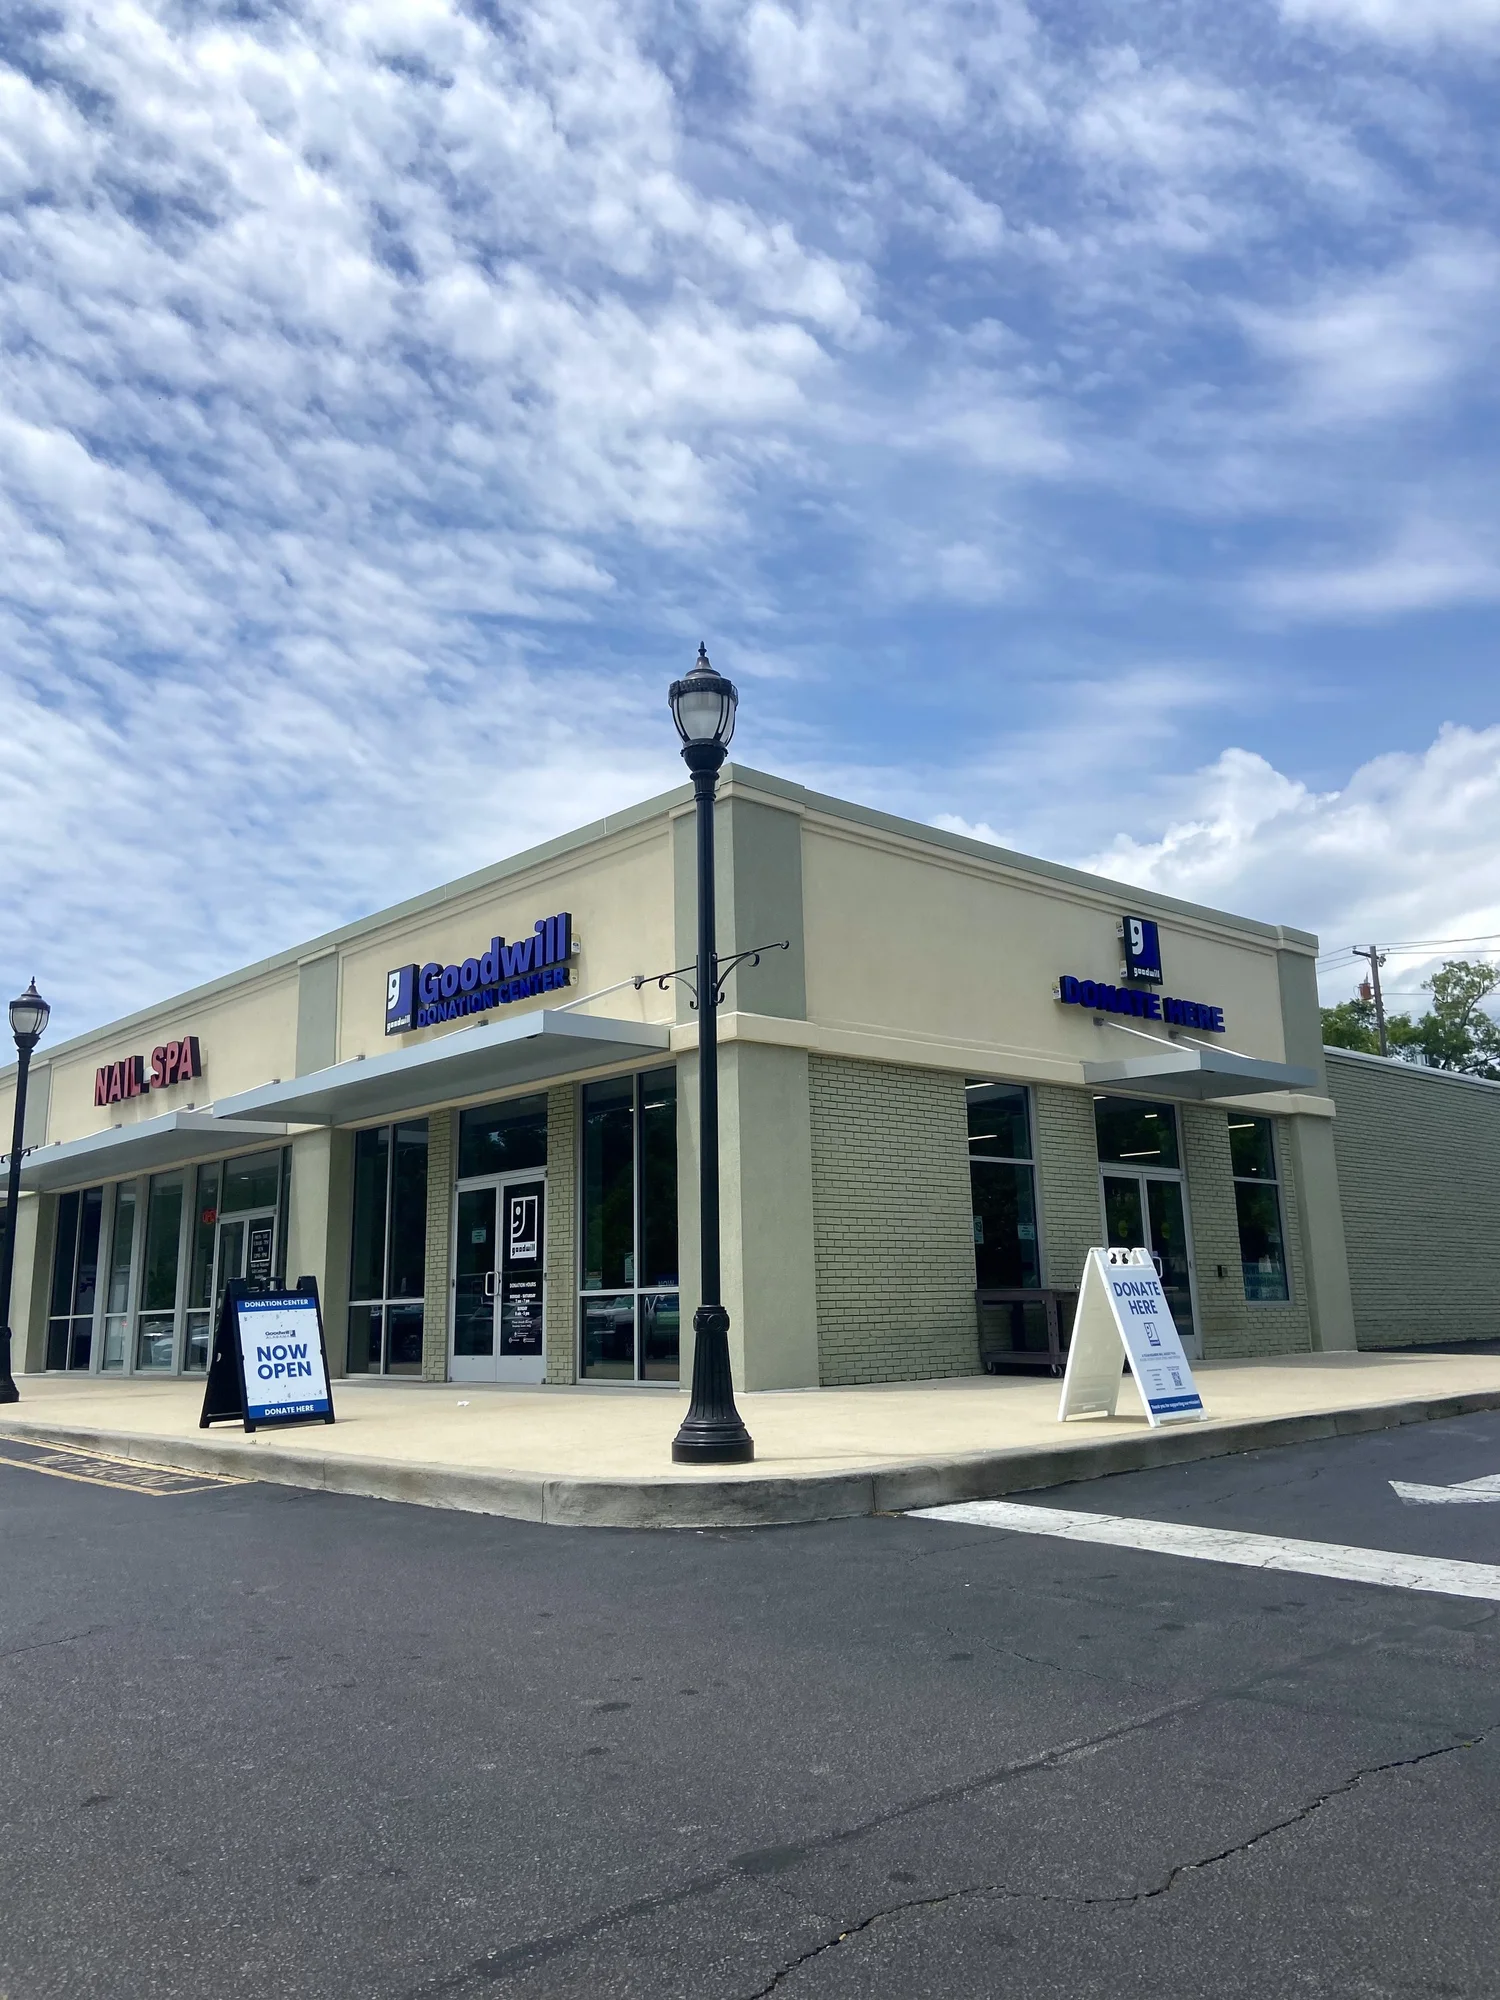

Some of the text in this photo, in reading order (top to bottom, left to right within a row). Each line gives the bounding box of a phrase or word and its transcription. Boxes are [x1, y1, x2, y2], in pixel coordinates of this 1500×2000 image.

[419, 912, 571, 1004] Goodwill
[1134, 967, 1160, 977] goodwill
[417, 967, 571, 1028] DONATION CENTER
[1059, 975, 1226, 1033] DONATE HERE
[94, 1036, 201, 1106] NAIL SPA
[1113, 1281, 1161, 1297] DONATE
[245, 1300, 281, 1308] DONATION
[1128, 1299, 1158, 1315] HERE
[257, 1344, 307, 1361] NOW
[257, 1361, 312, 1379] OPEN
[265, 1405, 314, 1416] DONATE HERE
